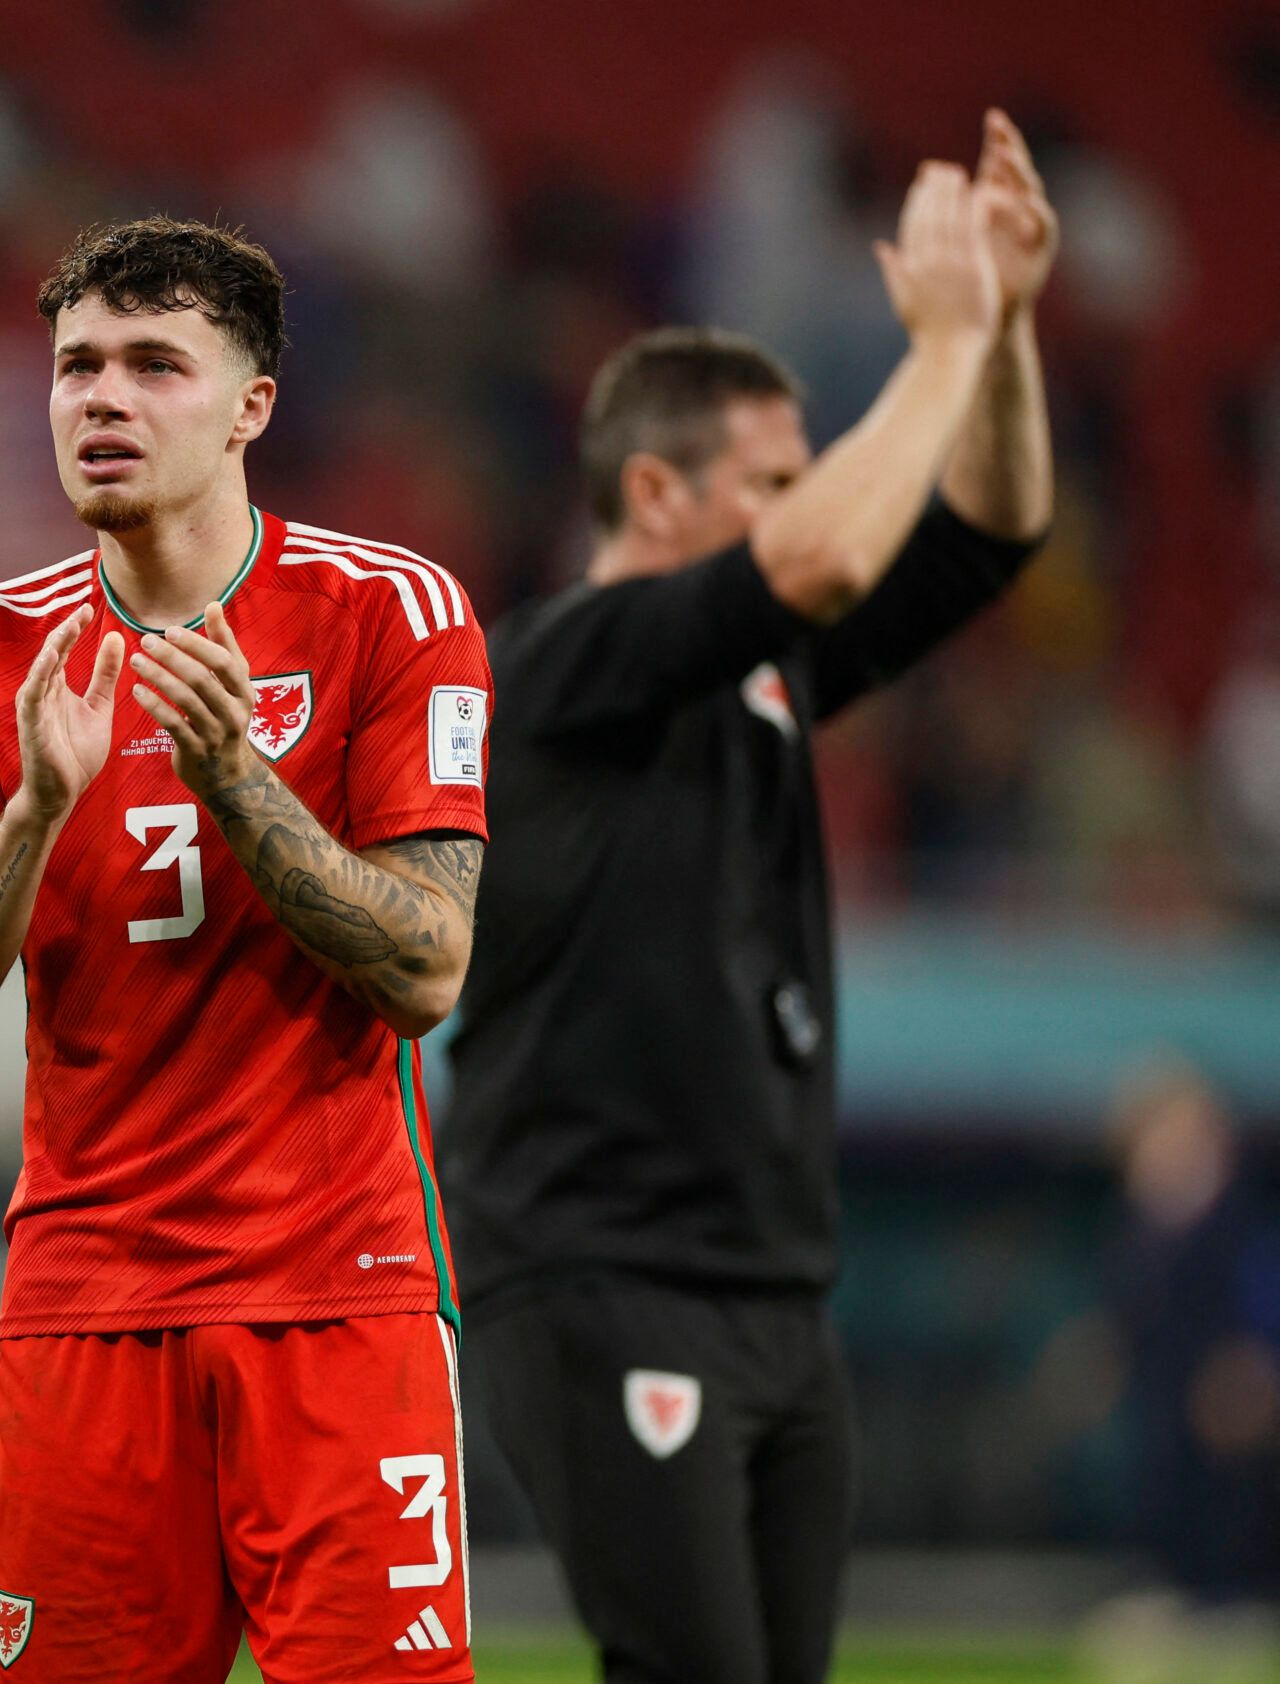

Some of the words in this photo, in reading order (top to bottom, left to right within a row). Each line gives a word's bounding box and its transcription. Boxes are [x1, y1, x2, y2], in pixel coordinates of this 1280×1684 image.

[130, 739, 139, 747] 21
[121, 747, 145, 756] AHMAD
[146, 746, 159, 754] BIN
[125, 803, 204, 943] 3
[377, 1254, 416, 1264] AEROREADY
[380, 1454, 452, 1588] 3
